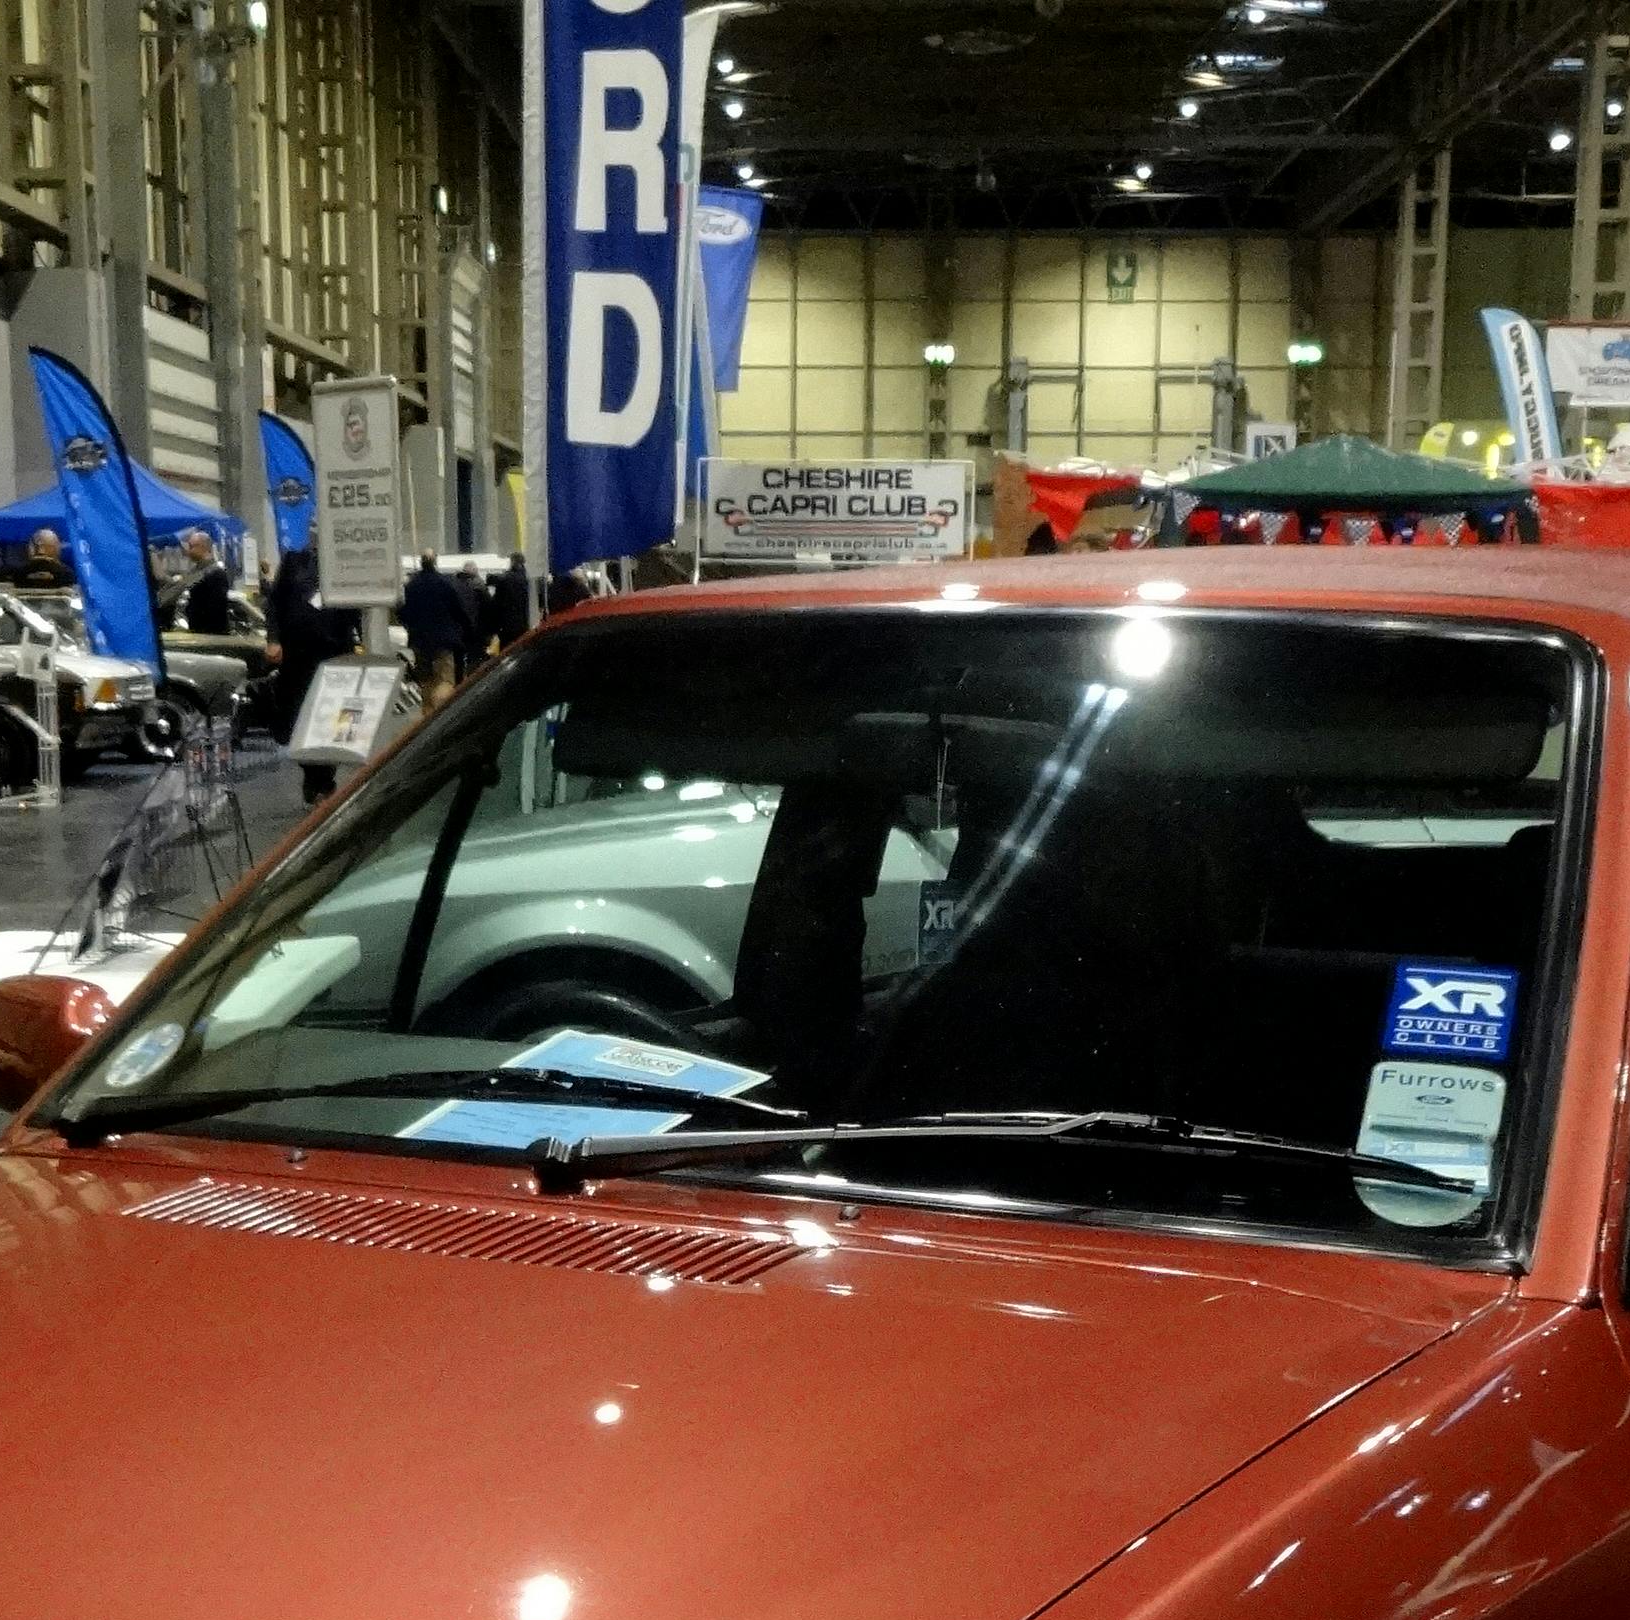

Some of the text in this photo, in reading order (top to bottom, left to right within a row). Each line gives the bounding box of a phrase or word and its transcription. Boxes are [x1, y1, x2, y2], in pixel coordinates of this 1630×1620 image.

[567, 0, 669, 448] RD
[763, 468, 913, 490] CHESHIRE
[747, 494, 927, 516] CAPRI CLUB
[1398, 977, 1506, 1017] XR
[1398, 1018, 1498, 1036] OWNERS
[1395, 1031, 1496, 1049] CLUB
[1380, 1069, 1496, 1092] Furrows
